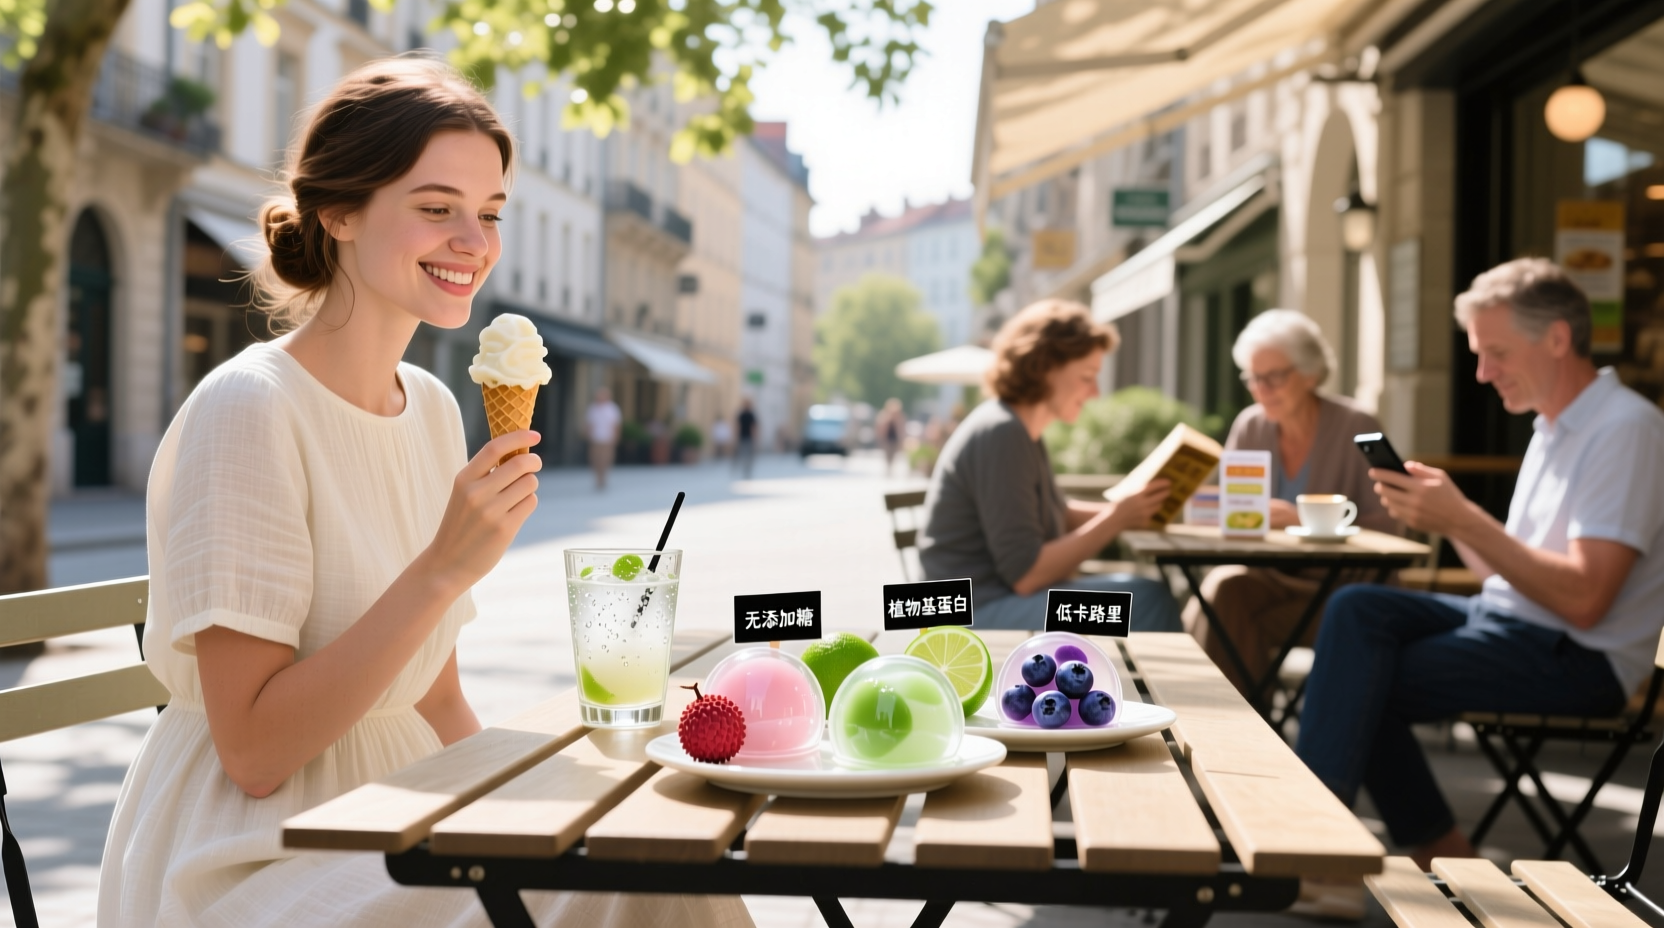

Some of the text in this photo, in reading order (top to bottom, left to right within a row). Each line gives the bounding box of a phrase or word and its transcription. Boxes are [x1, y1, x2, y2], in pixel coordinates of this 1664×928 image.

[888, 594, 967, 618] 植物基蛋白
[1056, 603, 1122, 623] 低卡路里
[745, 607, 814, 629] 无添加糖
